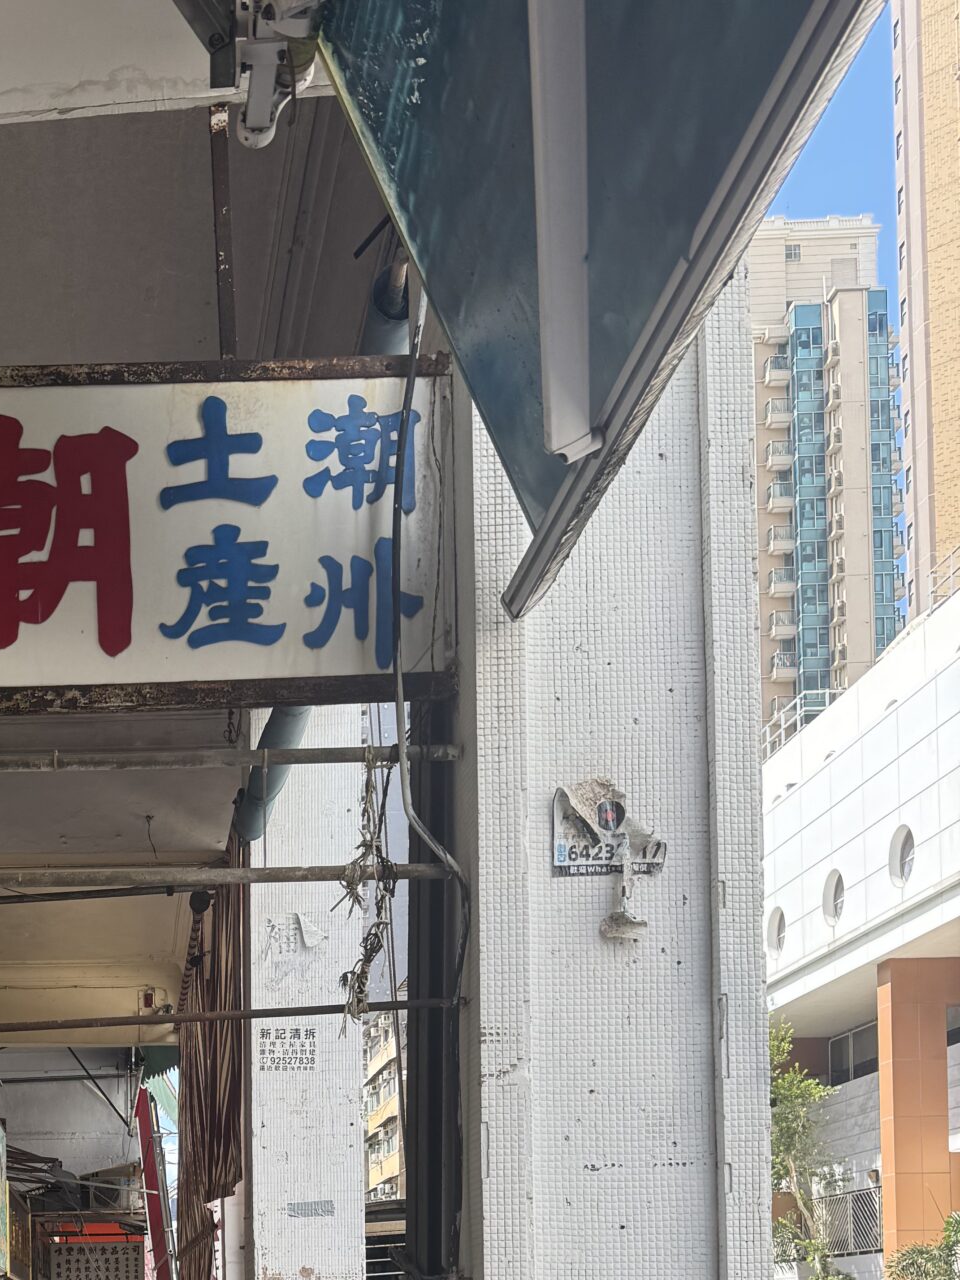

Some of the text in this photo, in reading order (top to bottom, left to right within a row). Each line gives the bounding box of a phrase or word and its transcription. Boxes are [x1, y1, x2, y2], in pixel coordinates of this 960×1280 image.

[302, 393, 425, 671] 潮州
[259, 1028, 316, 1040] 新記清拆
[270, 1056, 316, 1065] 92527838
